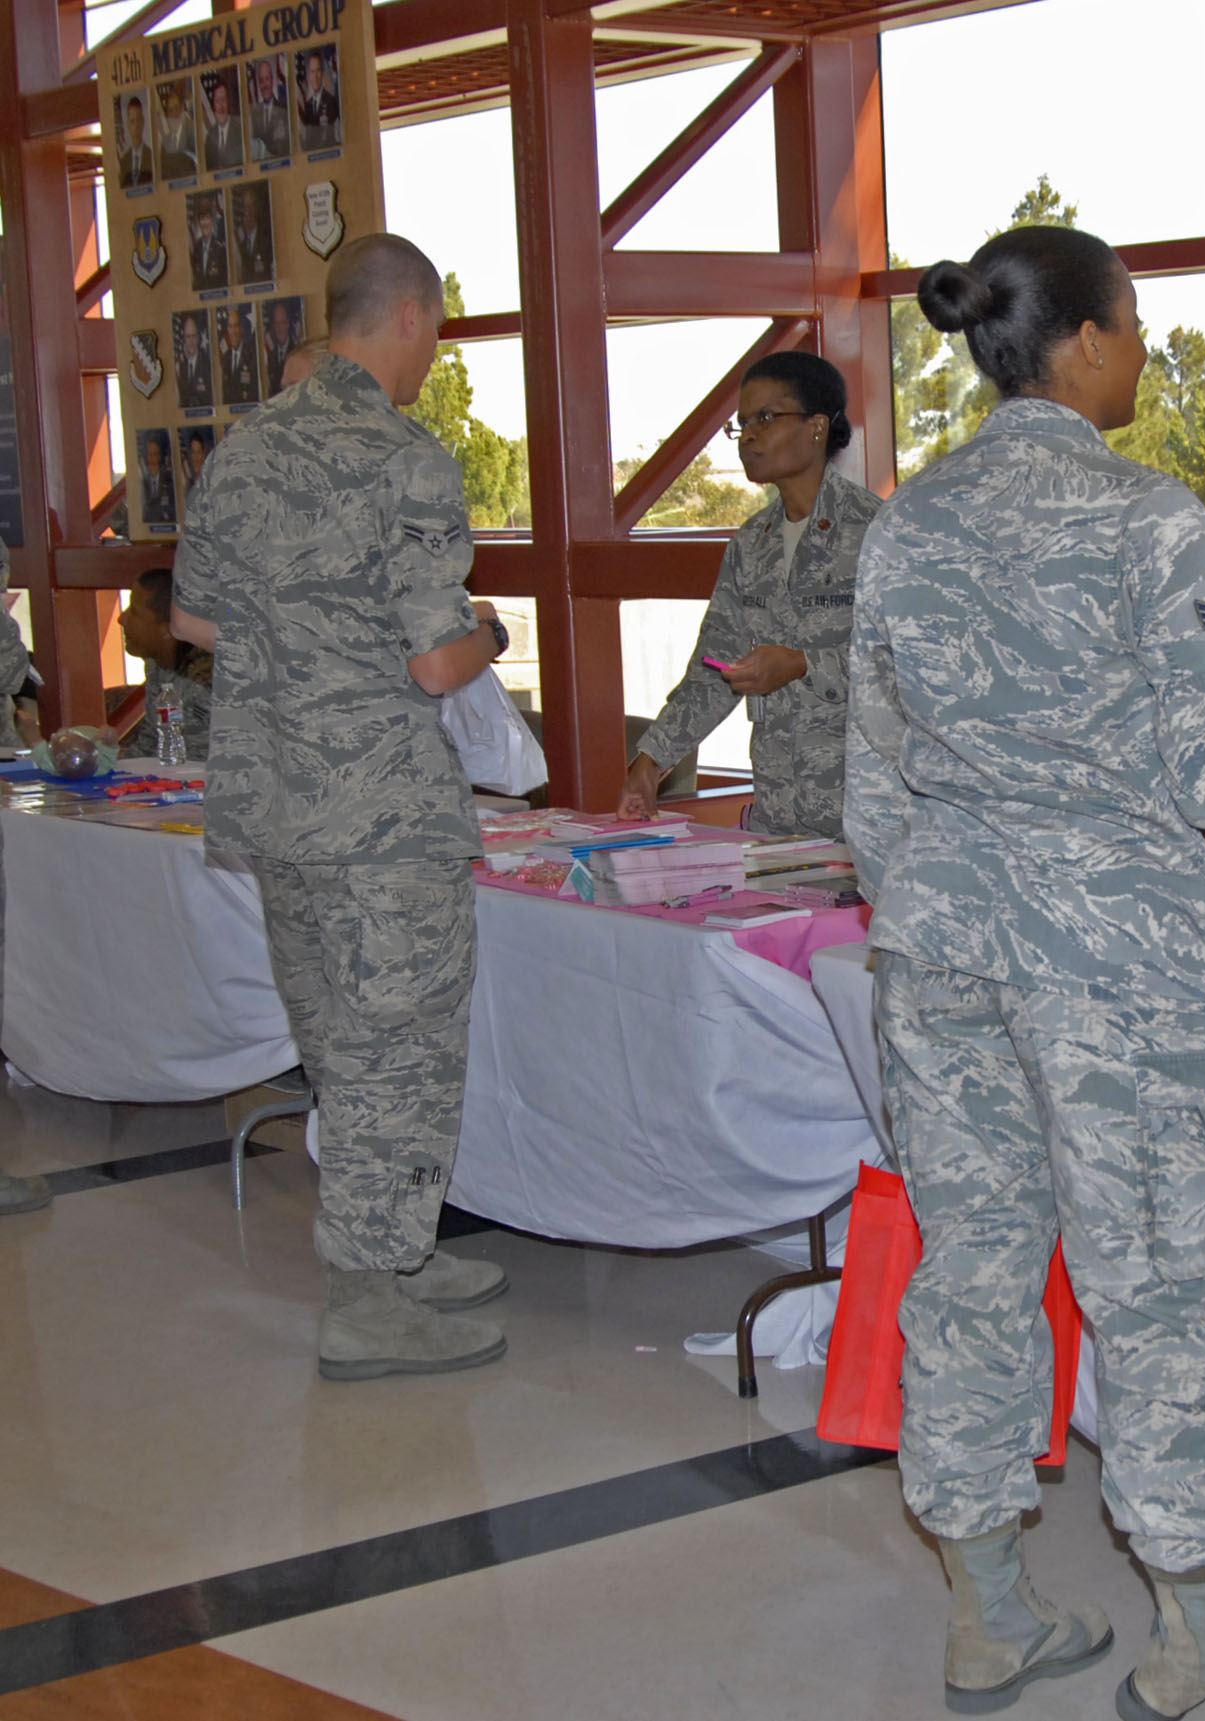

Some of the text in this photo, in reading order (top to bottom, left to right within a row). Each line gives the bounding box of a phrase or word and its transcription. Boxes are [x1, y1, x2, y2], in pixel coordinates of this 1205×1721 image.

[111, 0, 346, 87] 412th MEDICAL GROUP
